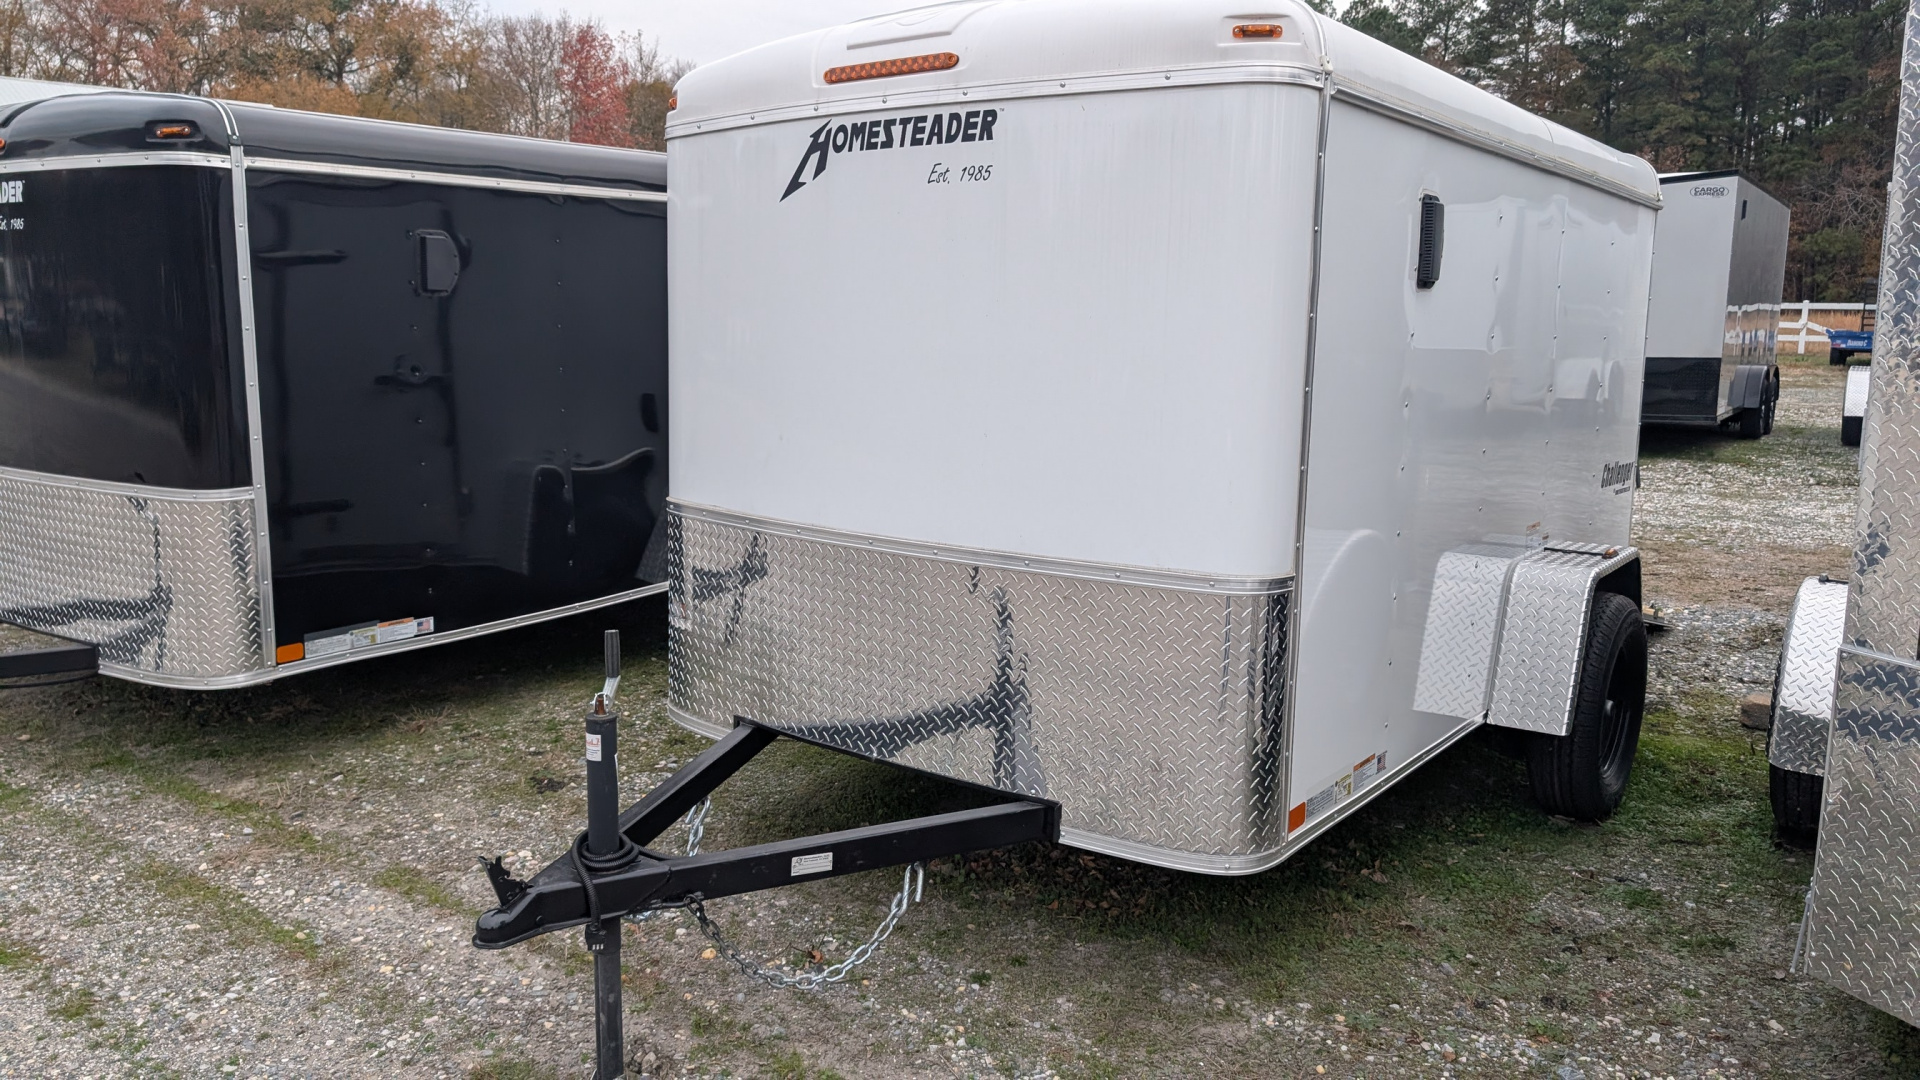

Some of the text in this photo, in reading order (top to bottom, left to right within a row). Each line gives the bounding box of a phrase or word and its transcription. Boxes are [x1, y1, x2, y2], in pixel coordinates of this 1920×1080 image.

[779, 109, 998, 203] HOMESTEADER
[927, 162, 993, 184] Est. 1985
[0, 180, 23, 203] DER
[10, 217, 25, 230] 1985
[1601, 460, 1635, 488] Challenger
